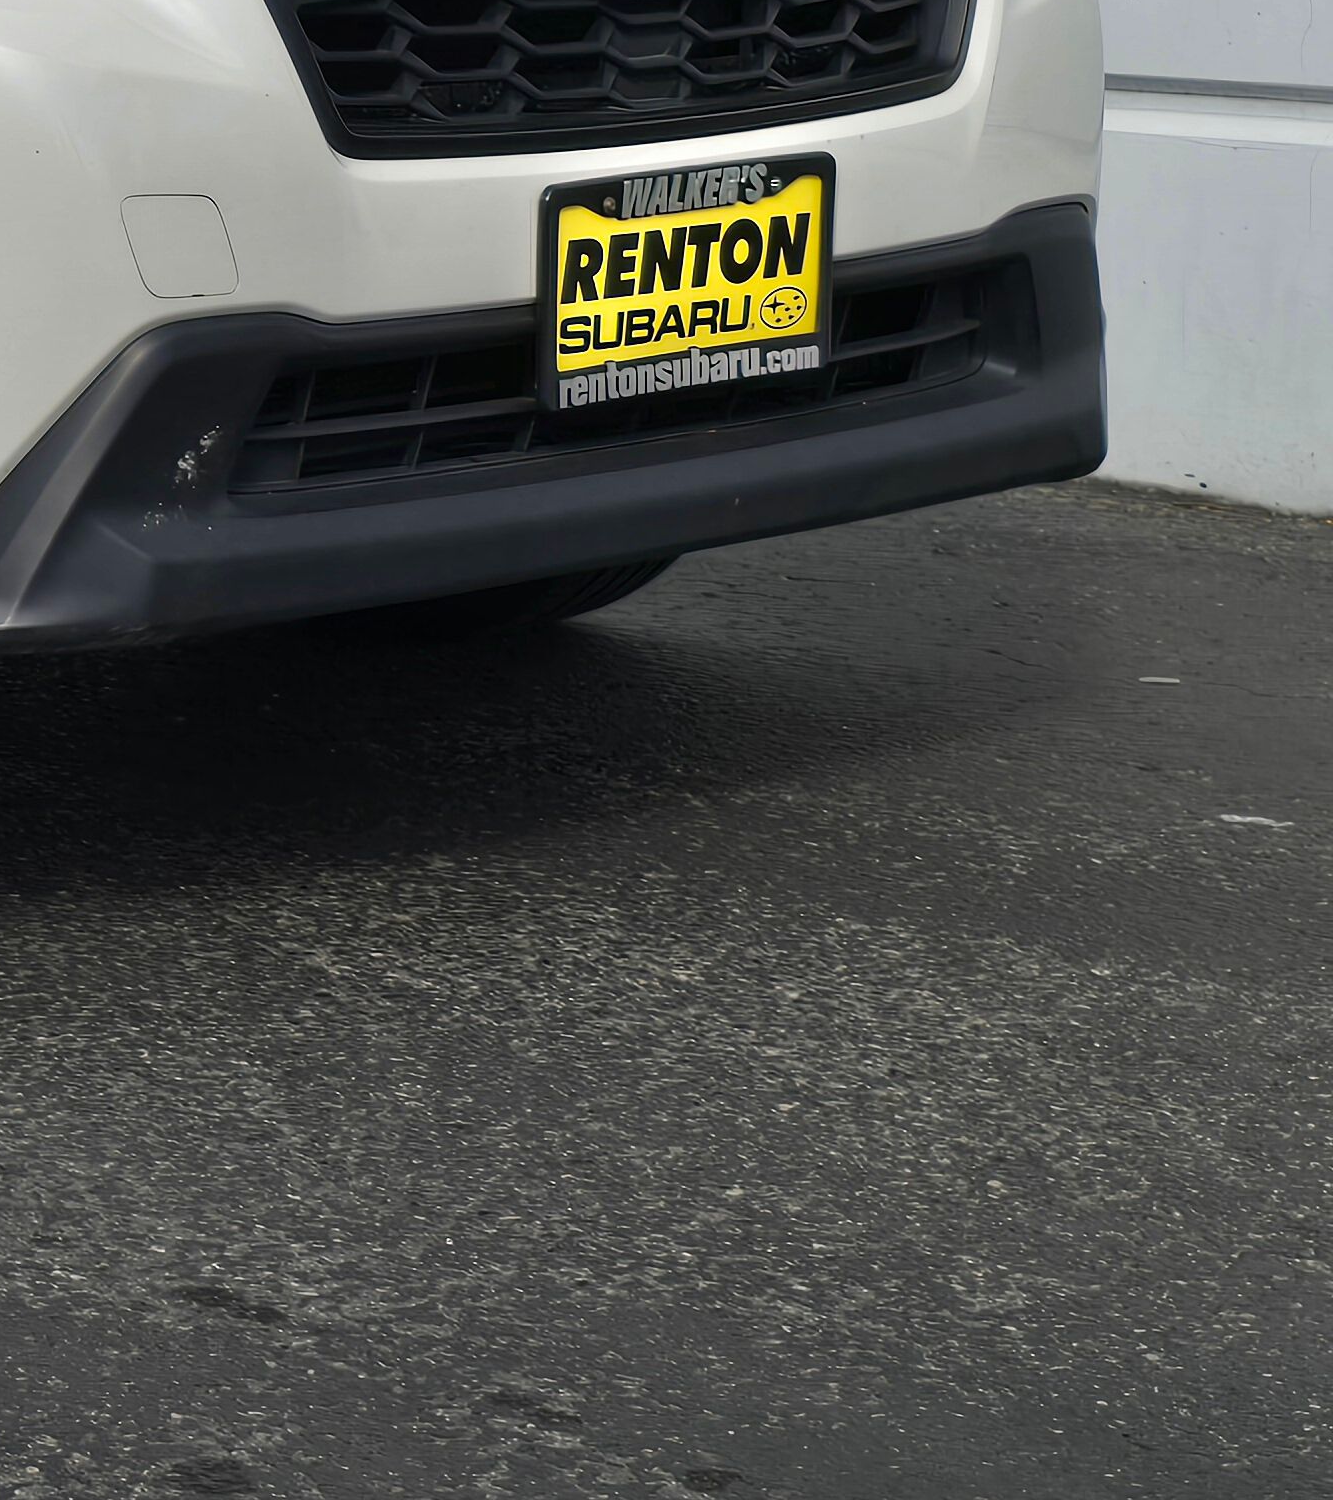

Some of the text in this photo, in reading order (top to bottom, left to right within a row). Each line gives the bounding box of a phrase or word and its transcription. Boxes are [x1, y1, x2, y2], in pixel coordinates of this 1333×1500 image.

[621, 163, 768, 219] WALKER'S
[560, 212, 811, 304] RENTON
[559, 295, 752, 354] SUBARU
[559, 345, 820, 409] rentonsubaru.com
